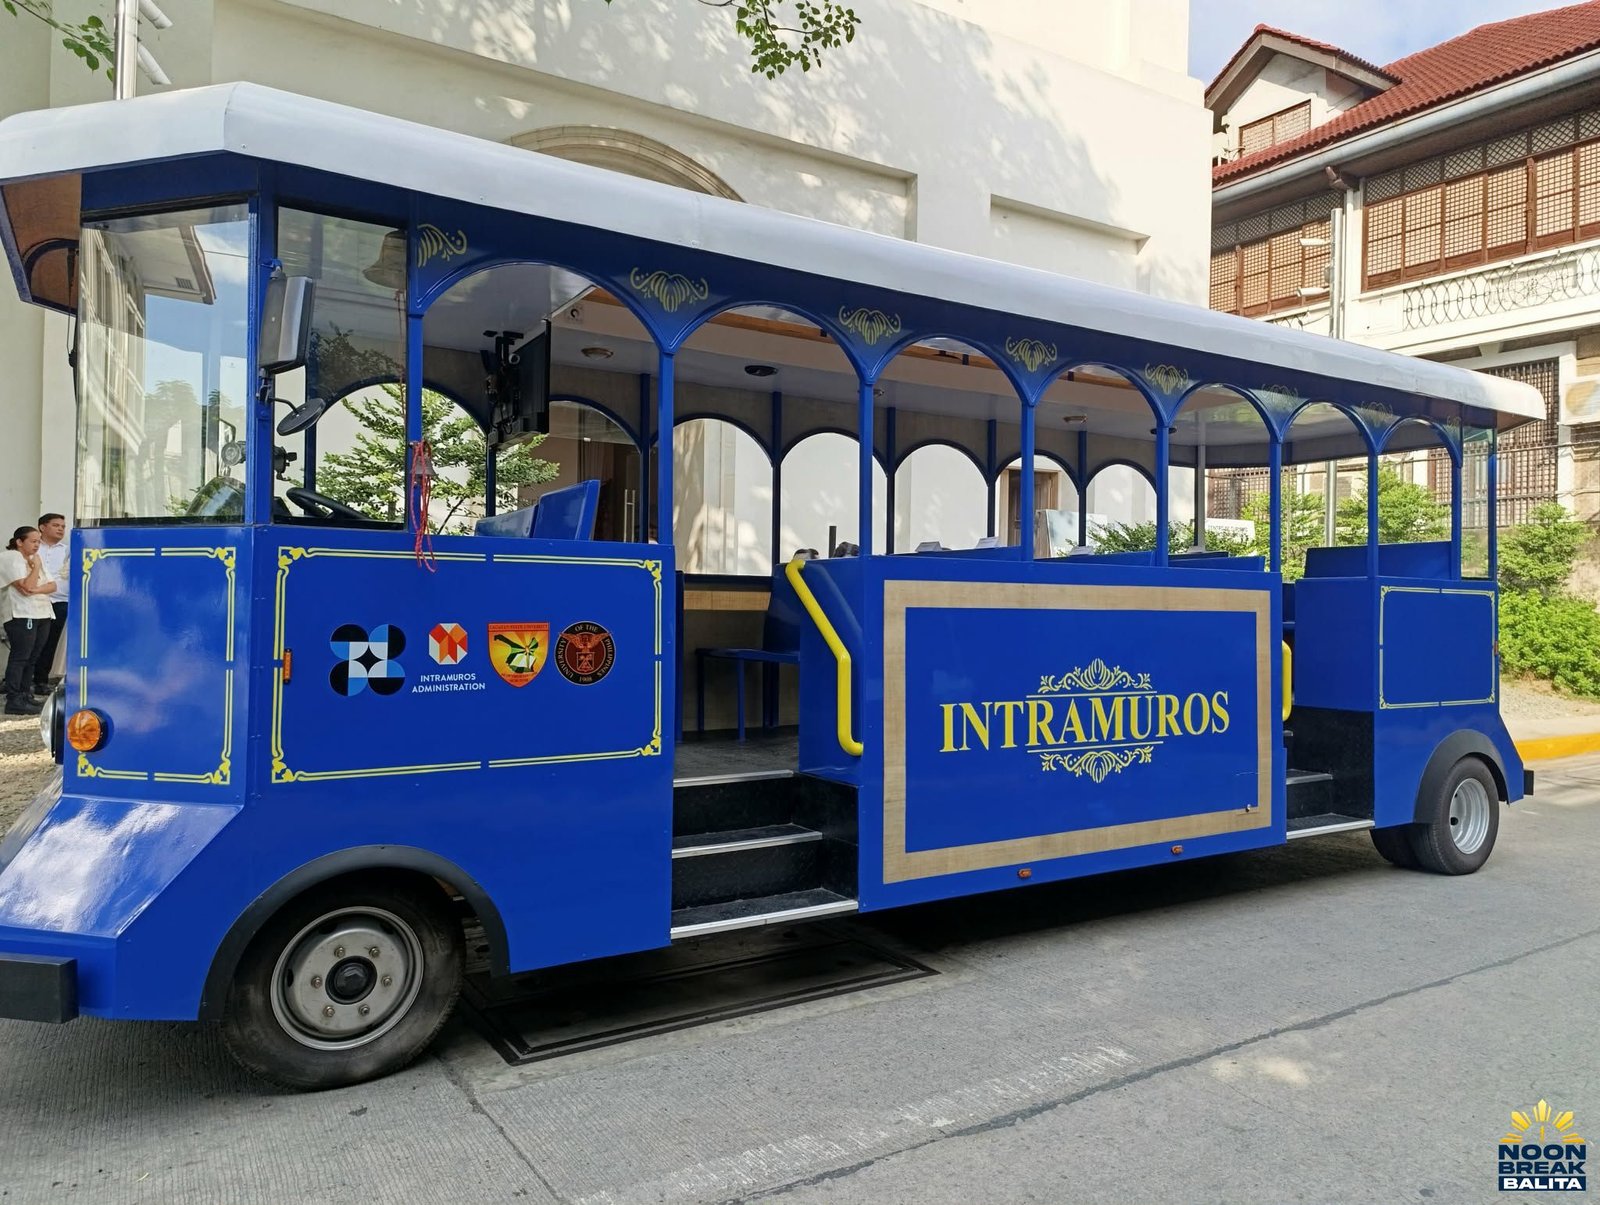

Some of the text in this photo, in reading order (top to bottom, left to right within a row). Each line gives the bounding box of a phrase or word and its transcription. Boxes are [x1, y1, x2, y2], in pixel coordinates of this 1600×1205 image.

[558, 624, 613, 679] UNIVERSITY OF THE PHILIPPINES
[412, 682, 486, 693] ADMINISTRATION
[420, 673, 476, 682] INTRAMUROS
[940, 691, 1230, 752] INTRAMUROS
